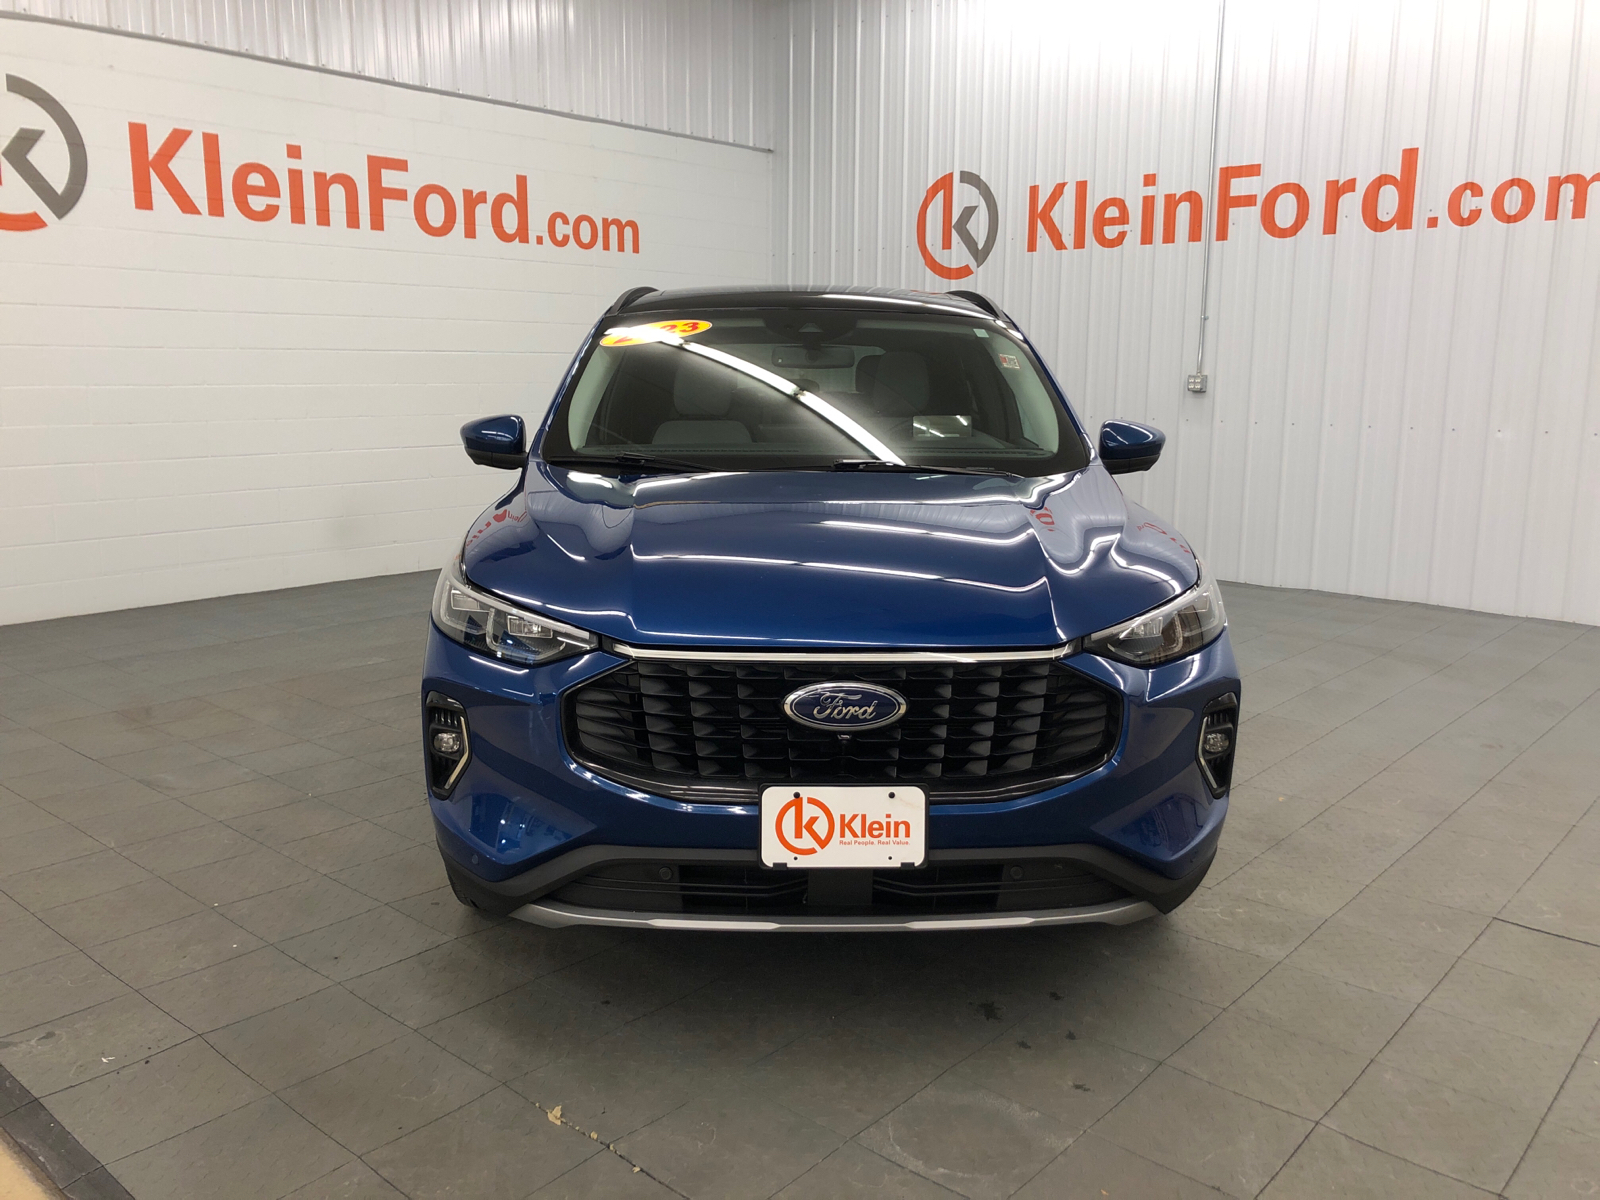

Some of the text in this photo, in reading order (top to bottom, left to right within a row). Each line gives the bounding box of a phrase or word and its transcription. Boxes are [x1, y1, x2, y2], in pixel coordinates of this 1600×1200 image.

[128, 121, 641, 255] KleinFord.com
[1026, 147, 1600, 253] KleinFord.com
[813, 692, 879, 720] Ford
[839, 813, 911, 839] Klein
